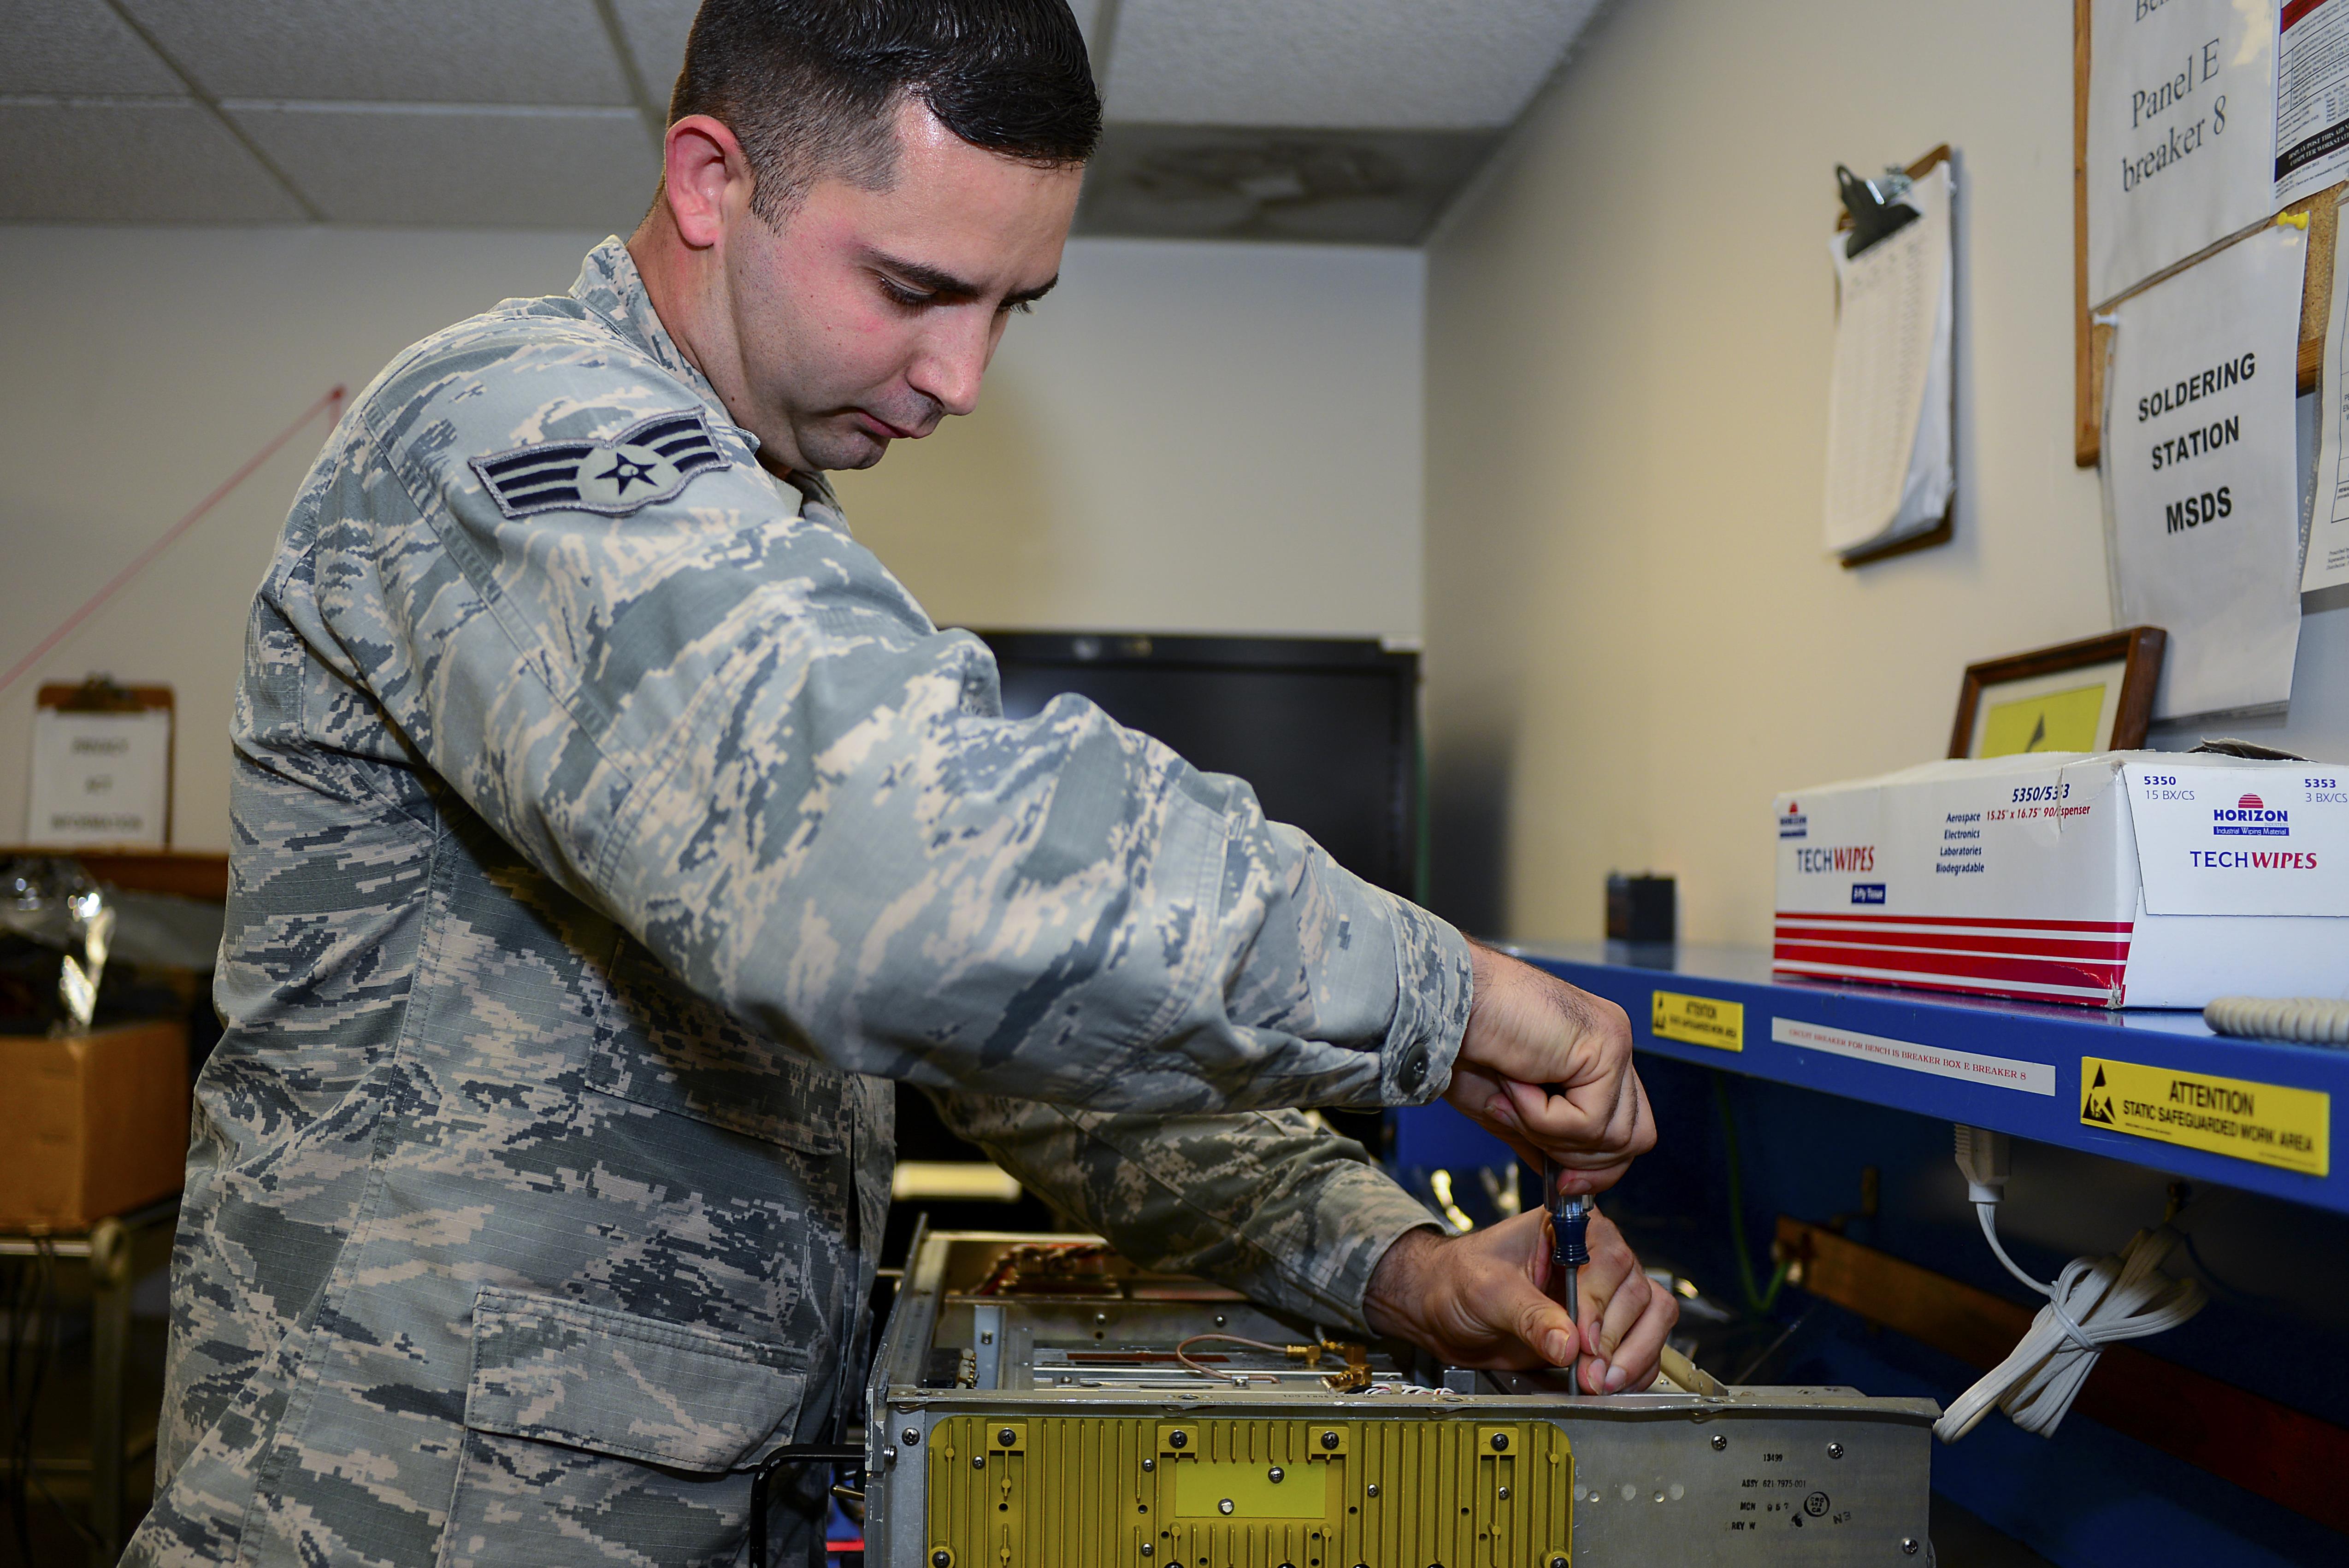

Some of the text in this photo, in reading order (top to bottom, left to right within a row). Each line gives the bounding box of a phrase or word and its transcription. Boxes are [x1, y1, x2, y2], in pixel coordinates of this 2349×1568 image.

[2131, 54, 2193, 130] Panel
[2201, 38, 2220, 83] E
[2122, 119, 2206, 193] breaker
[2213, 95, 2227, 135] 8
[2138, 352, 2255, 422] SOLDERING
[2152, 416, 2240, 471] STATION
[2166, 486, 2232, 535] MSDS
[2144, 776, 2176, 785] 5350
[2305, 778, 2337, 788] 5353
[2012, 784, 2070, 802] 5350/533
[2146, 790, 2195, 800] 15 BX/CS
[2305, 793, 2348, 803] 3 BX/CS
[1946, 812, 1981, 824] Aerospace
[2213, 809, 2289, 822] HORIZON
[1944, 829, 1980, 840] Electronics
[2241, 827, 2261, 836] Wiping
[1940, 845, 1982, 857] Laboratories
[1936, 862, 1984, 876] Biodegradable
[1814, 1032, 1846, 1047] BREAKER
[1848, 1041, 1863, 1050] FOR
[1865, 1043, 1890, 1055] BENCH
[1893, 1049, 1900, 1057] IS
[1902, 1051, 1940, 1065] BREAKER
[1943, 1058, 1961, 1068] BOX
[1964, 1062, 1970, 1070] E
[1973, 1064, 2017, 1079] BREAKER
[2169, 1080, 2254, 1118] ATTENTION
[2124, 1100, 2155, 1120] STATIC
[2158, 1107, 2238, 1138] SAFEGUARDED
[2241, 1124, 2274, 1144] WORK
[2280, 1132, 2313, 1152] AREA
[1763, 1454, 1782, 1462] 13499
[1741, 1479, 1759, 1487] ASSY
[1740, 1502, 1756, 1511] MCN
[1732, 1522, 1745, 1530] REV
